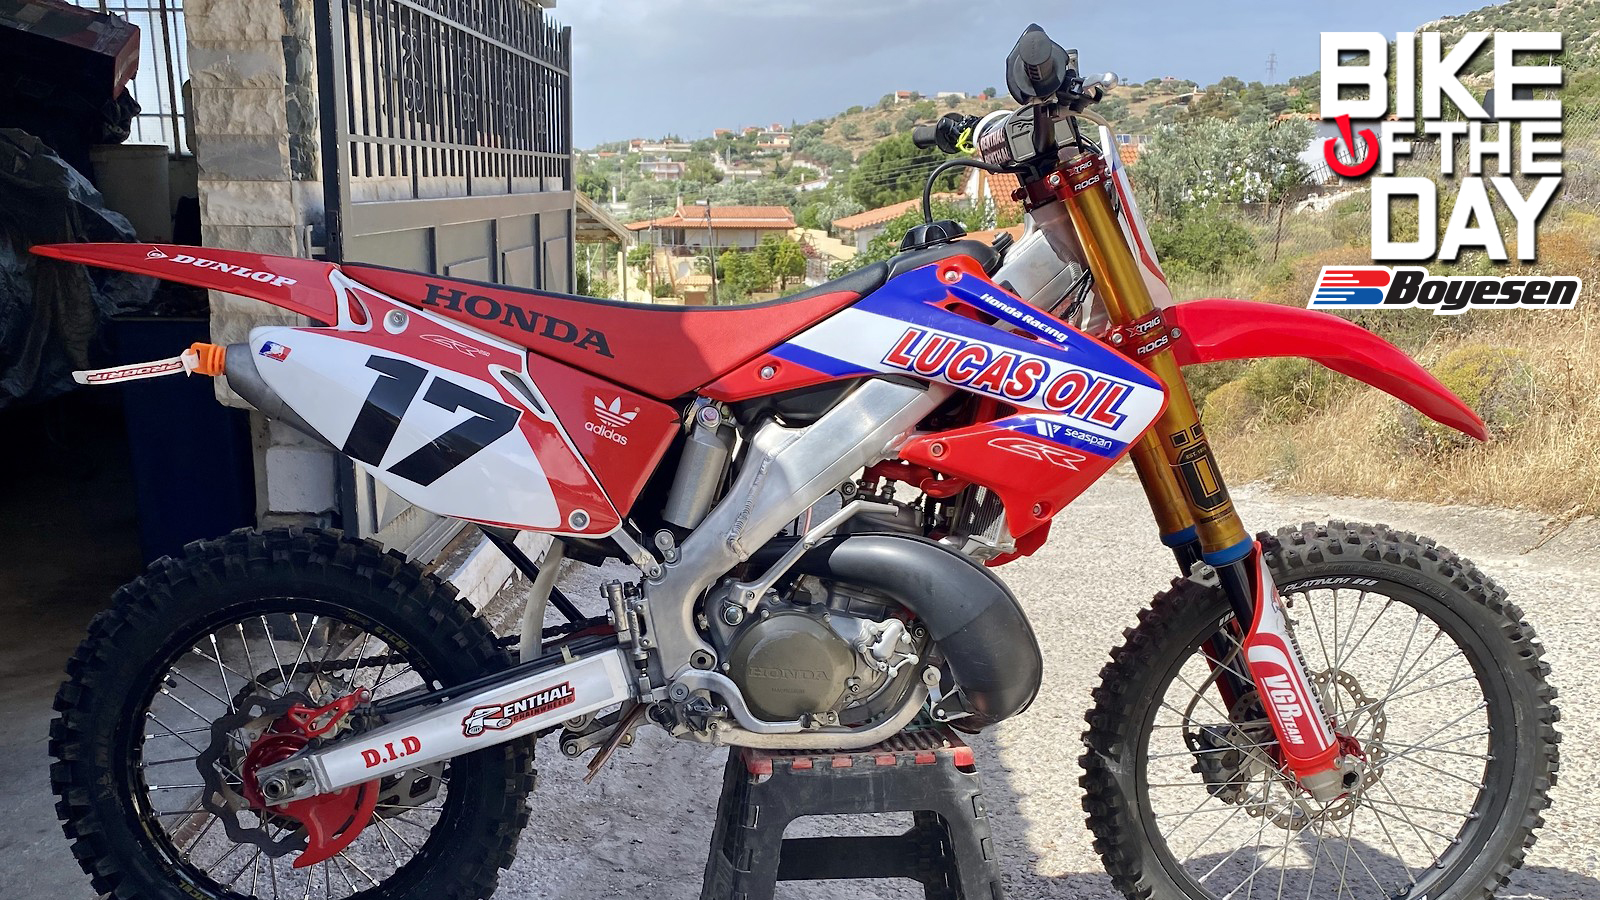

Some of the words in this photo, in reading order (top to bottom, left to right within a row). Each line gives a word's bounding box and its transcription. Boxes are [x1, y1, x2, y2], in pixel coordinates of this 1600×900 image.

[1074, 175, 1100, 191] ROCS
[168, 254, 297, 287] DUNLOP
[421, 283, 615, 359] HONDA
[980, 292, 1024, 323] Honda
[1022, 312, 1069, 343] Racing
[1126, 316, 1160, 338] XTRIG
[1137, 335, 1168, 357] ROCS
[880, 327, 1051, 401] LUCAS
[1042, 369, 1134, 431] OIL
[340, 354, 524, 487] 17
[584, 421, 628, 446] adidas
[1064, 427, 1113, 450] seaspan
[1284, 577, 1350, 593] PLATINUM
[748, 666, 832, 681] HONDA
[465, 684, 573, 735] RENTHAL
[360, 735, 421, 768] D.I.D
